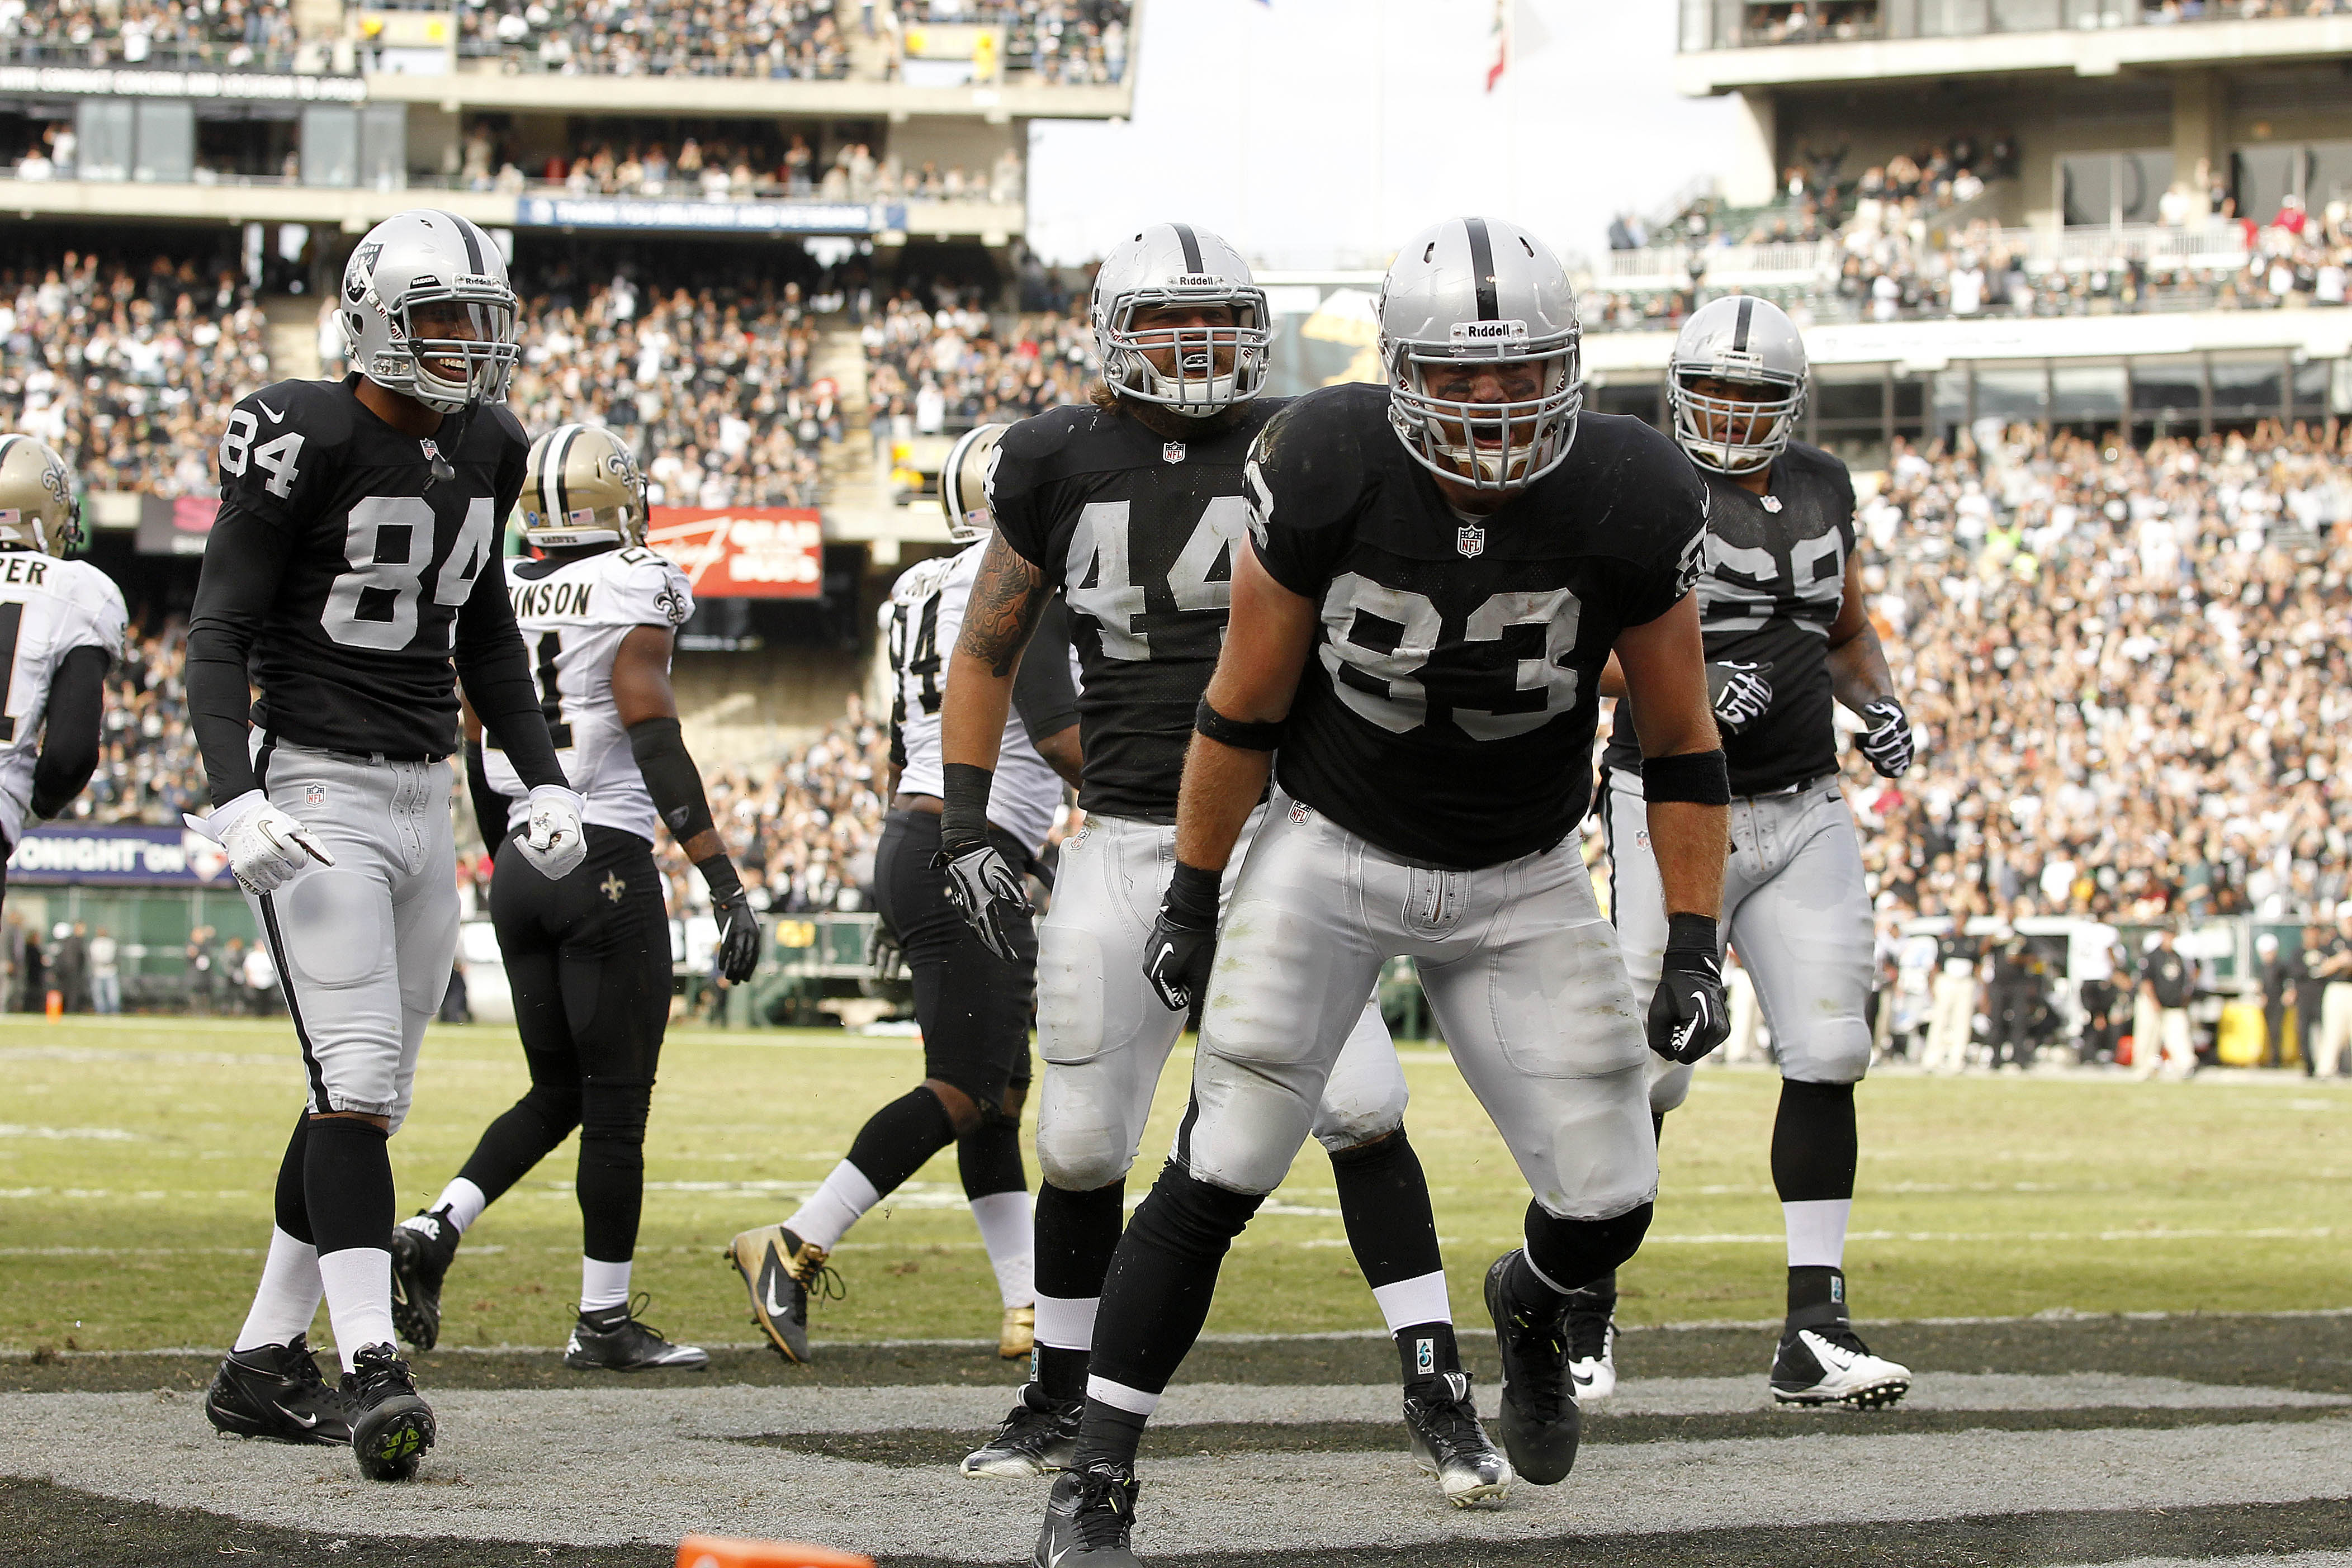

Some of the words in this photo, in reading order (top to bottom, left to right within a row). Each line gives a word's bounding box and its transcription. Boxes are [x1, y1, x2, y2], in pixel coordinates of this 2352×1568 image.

[1180, 276, 1213, 286] Riddell
[378, 308, 403, 339] Riell
[1468, 324, 1509, 337] Riddell
[220, 409, 305, 499] 84
[1167, 451, 1181, 459] NFL
[1462, 539, 1480, 552] NFL
[0, 557, 47, 585] ER
[320, 497, 495, 651] 84
[1066, 496, 1246, 661] 44
[508, 582, 593, 617] INSON
[1318, 572, 1581, 741] 83
[308, 794, 323, 803] NFL
[1291, 807, 1306, 822] NFL
